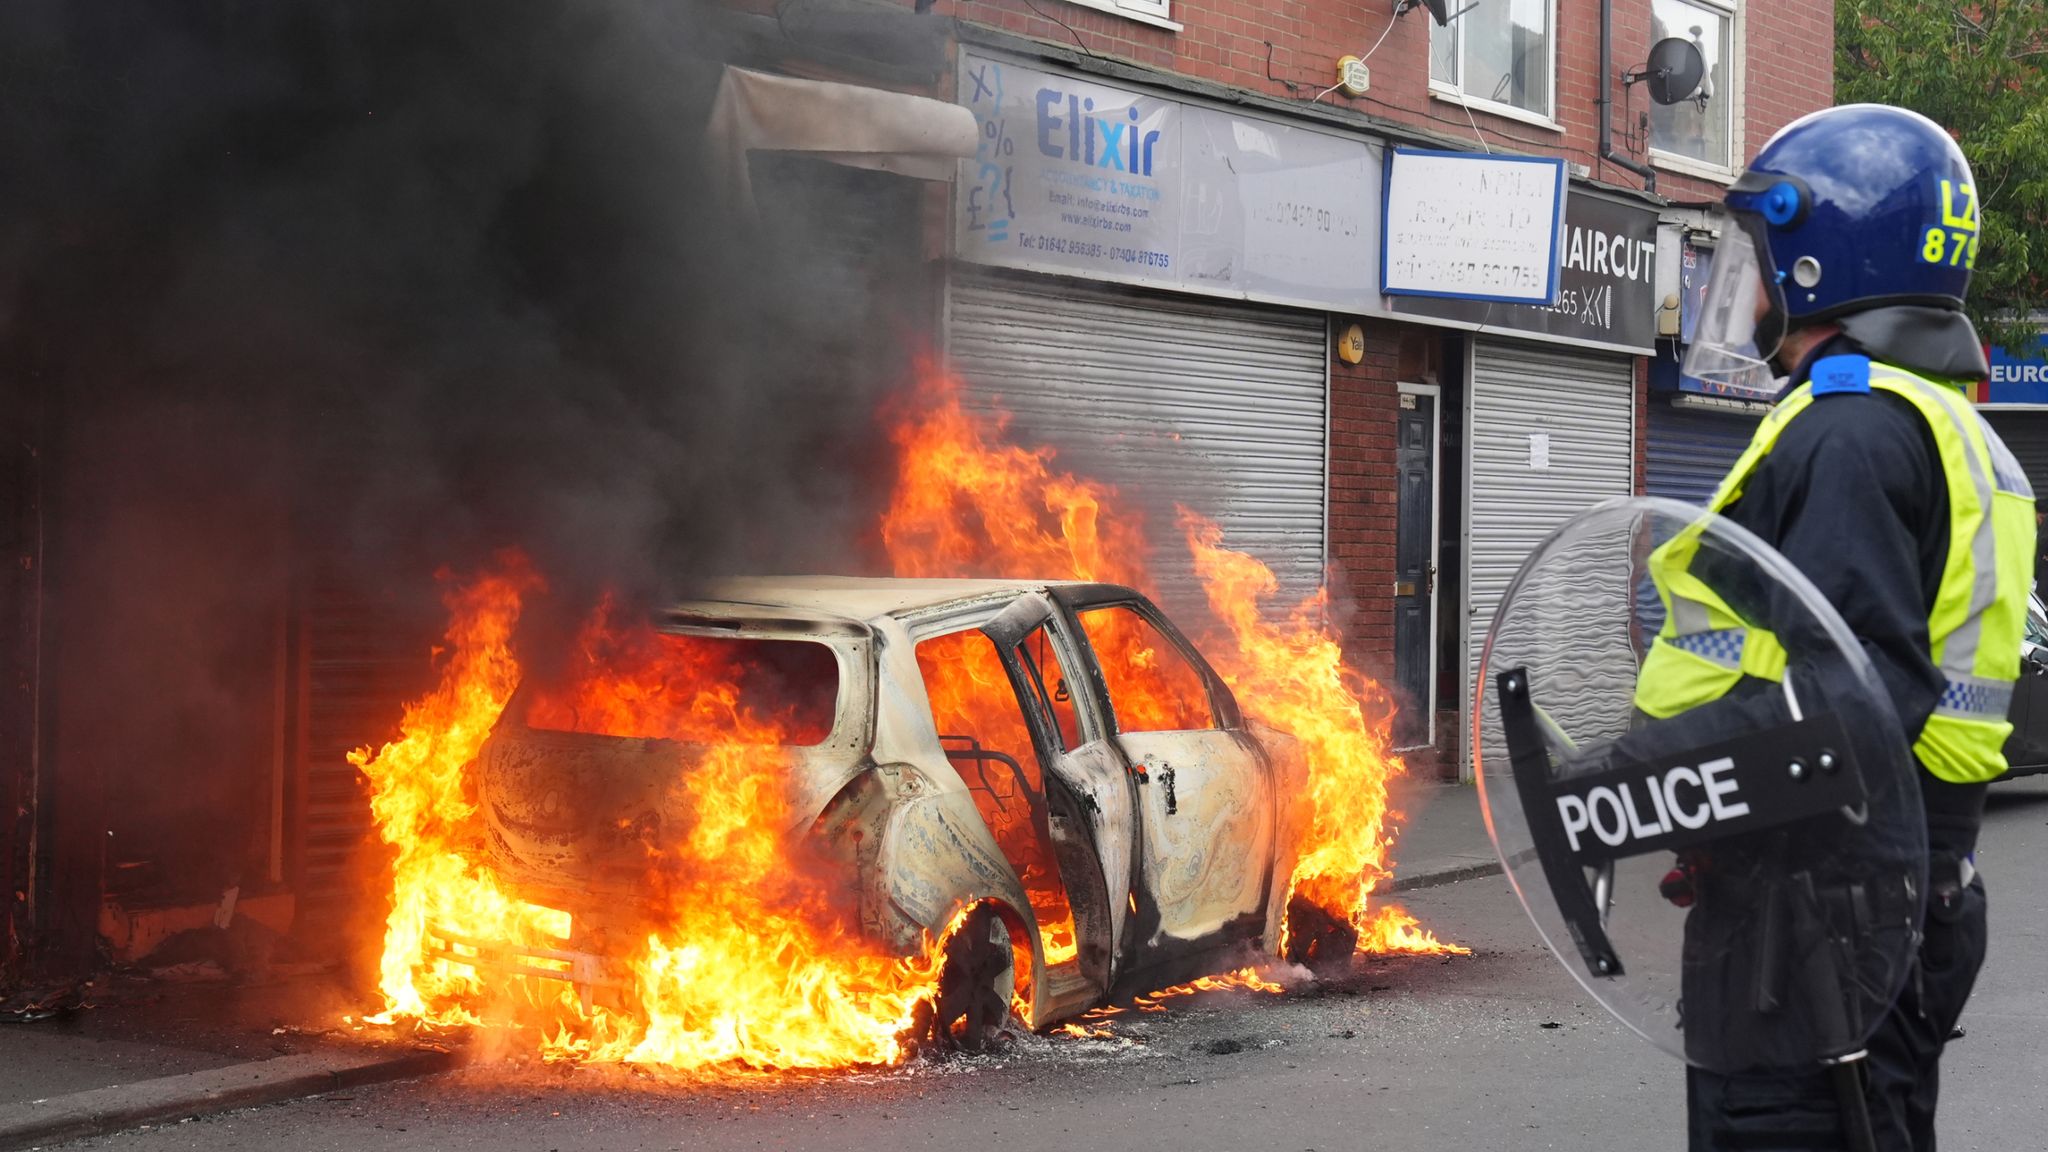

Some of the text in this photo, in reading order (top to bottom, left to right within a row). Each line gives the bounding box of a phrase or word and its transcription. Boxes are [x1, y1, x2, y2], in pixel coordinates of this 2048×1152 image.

[1036, 88, 1160, 177] Elixir
[1119, 181, 1160, 201] TAXATION
[1019, 232, 1036, 248] Tel:
[1038, 234, 1067, 253] 01642
[1109, 246, 1136, 263] 07404
[1138, 249, 1169, 268] 876755
[1556, 757, 1750, 852] POLICE
